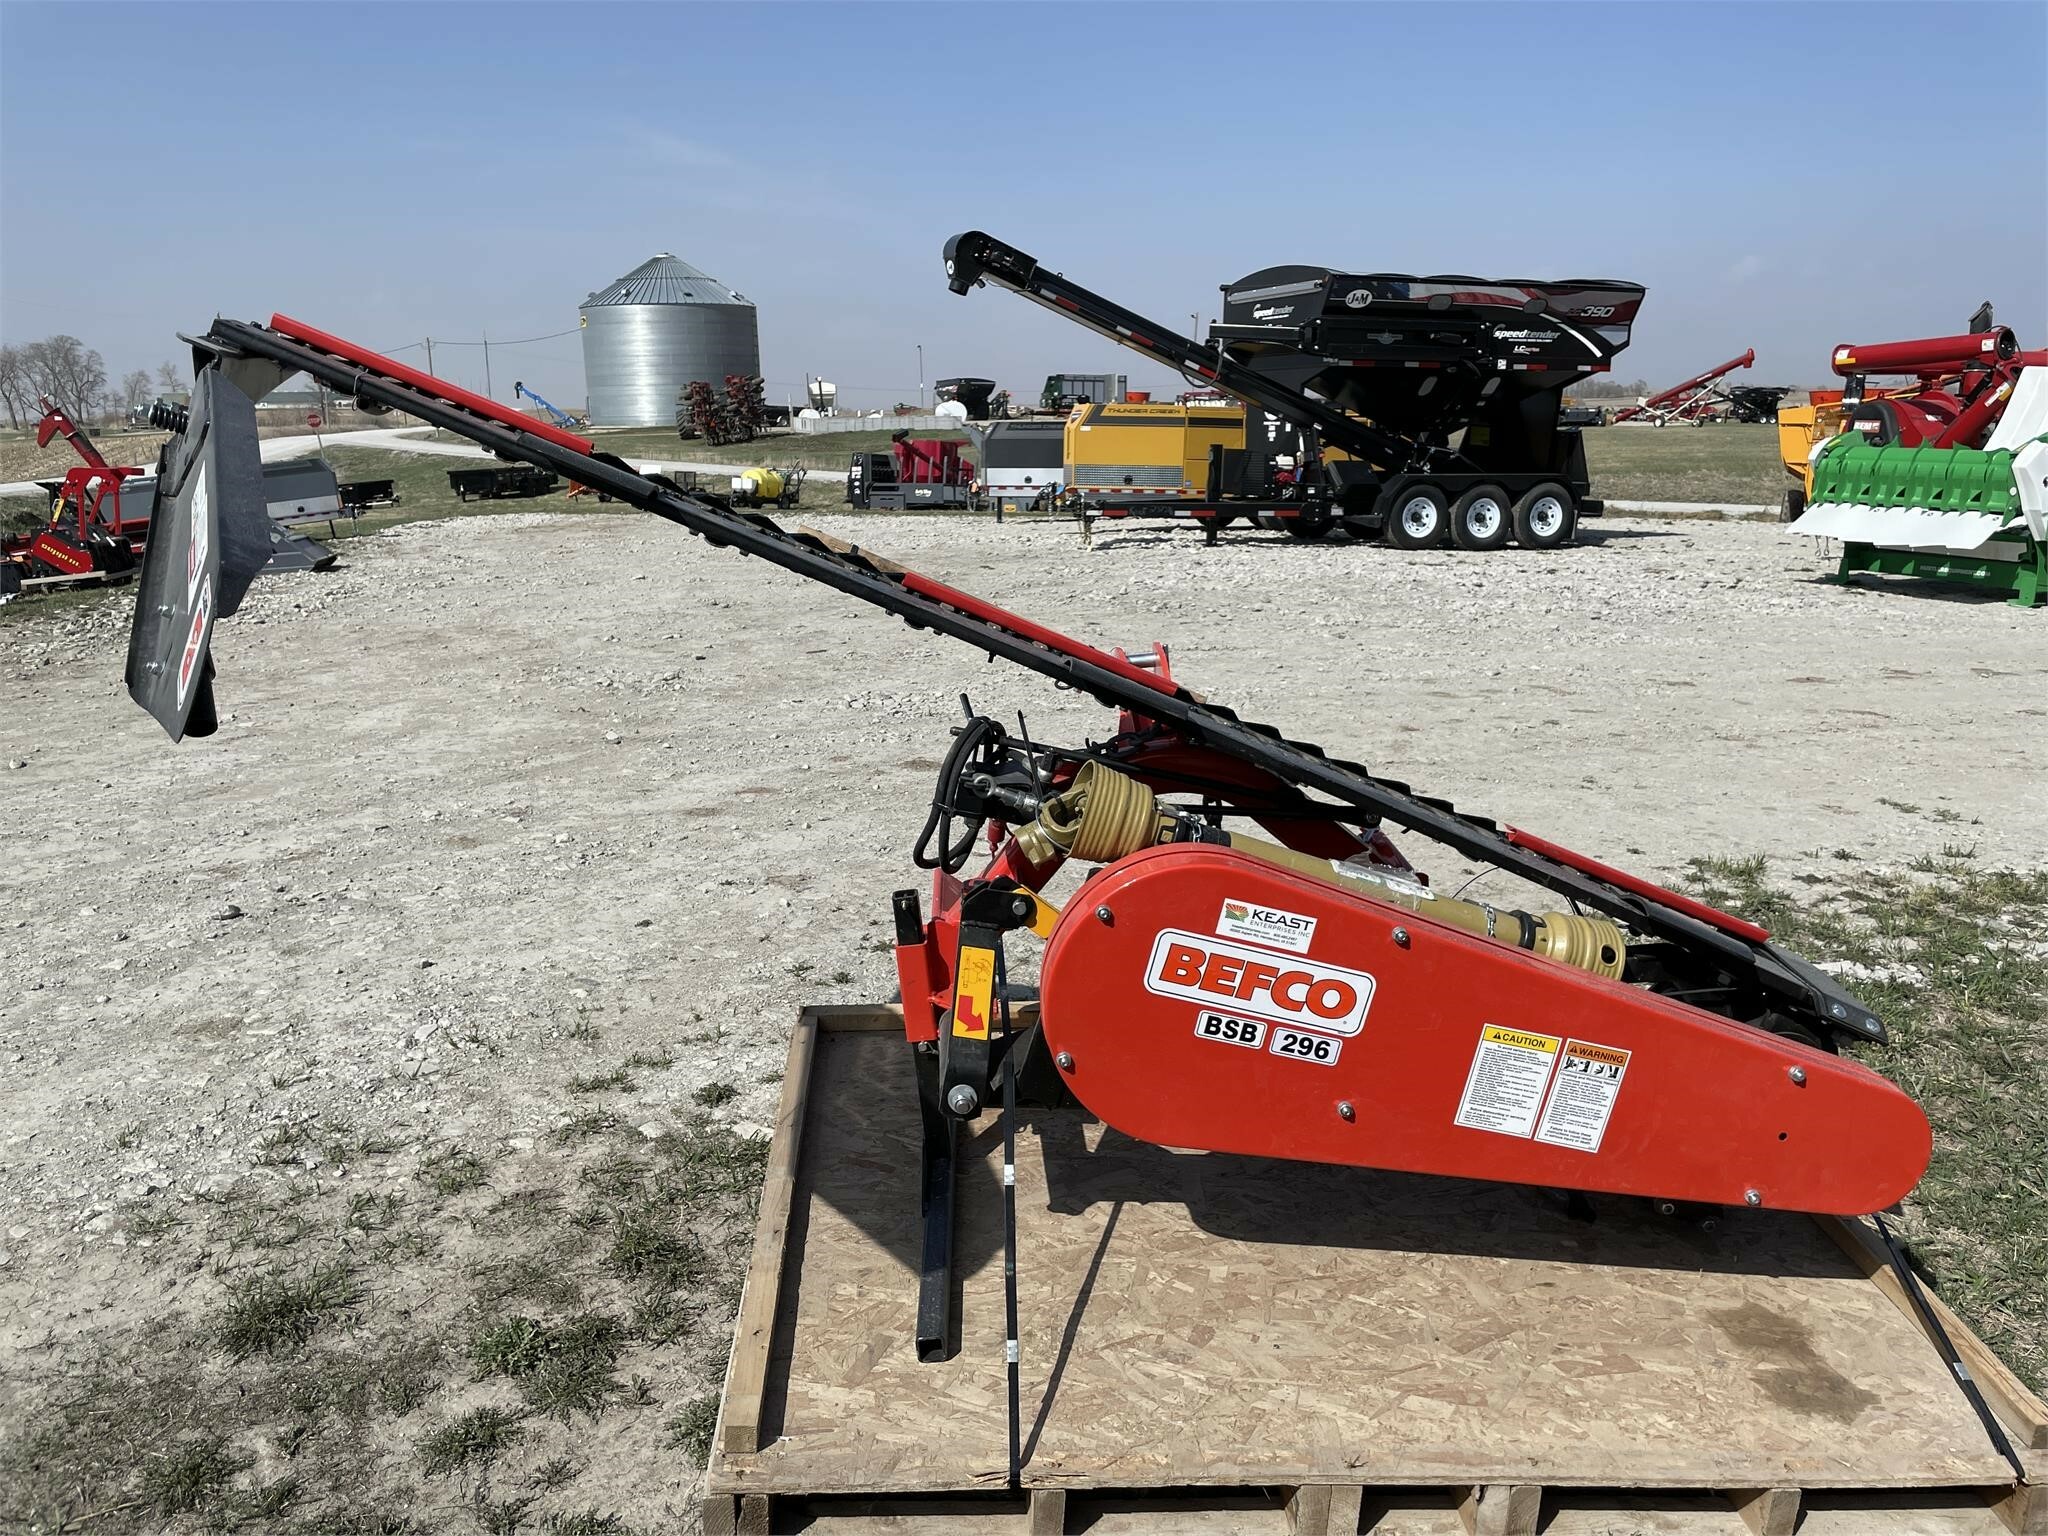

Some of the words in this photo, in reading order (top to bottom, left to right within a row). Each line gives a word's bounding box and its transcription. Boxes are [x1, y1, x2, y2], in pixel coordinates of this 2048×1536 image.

[1493, 329, 1561, 339] speedtender
[1250, 920, 1297, 936] ENTERPRISES
[1252, 909, 1314, 931] KEAST
[1158, 943, 1357, 1019] BEFCO
[1204, 1015, 1258, 1043] BSB
[1280, 1034, 1331, 1060] 296
[1502, 1033, 1546, 1048] CAUTION
[1579, 1047, 1624, 1064] WARNING
